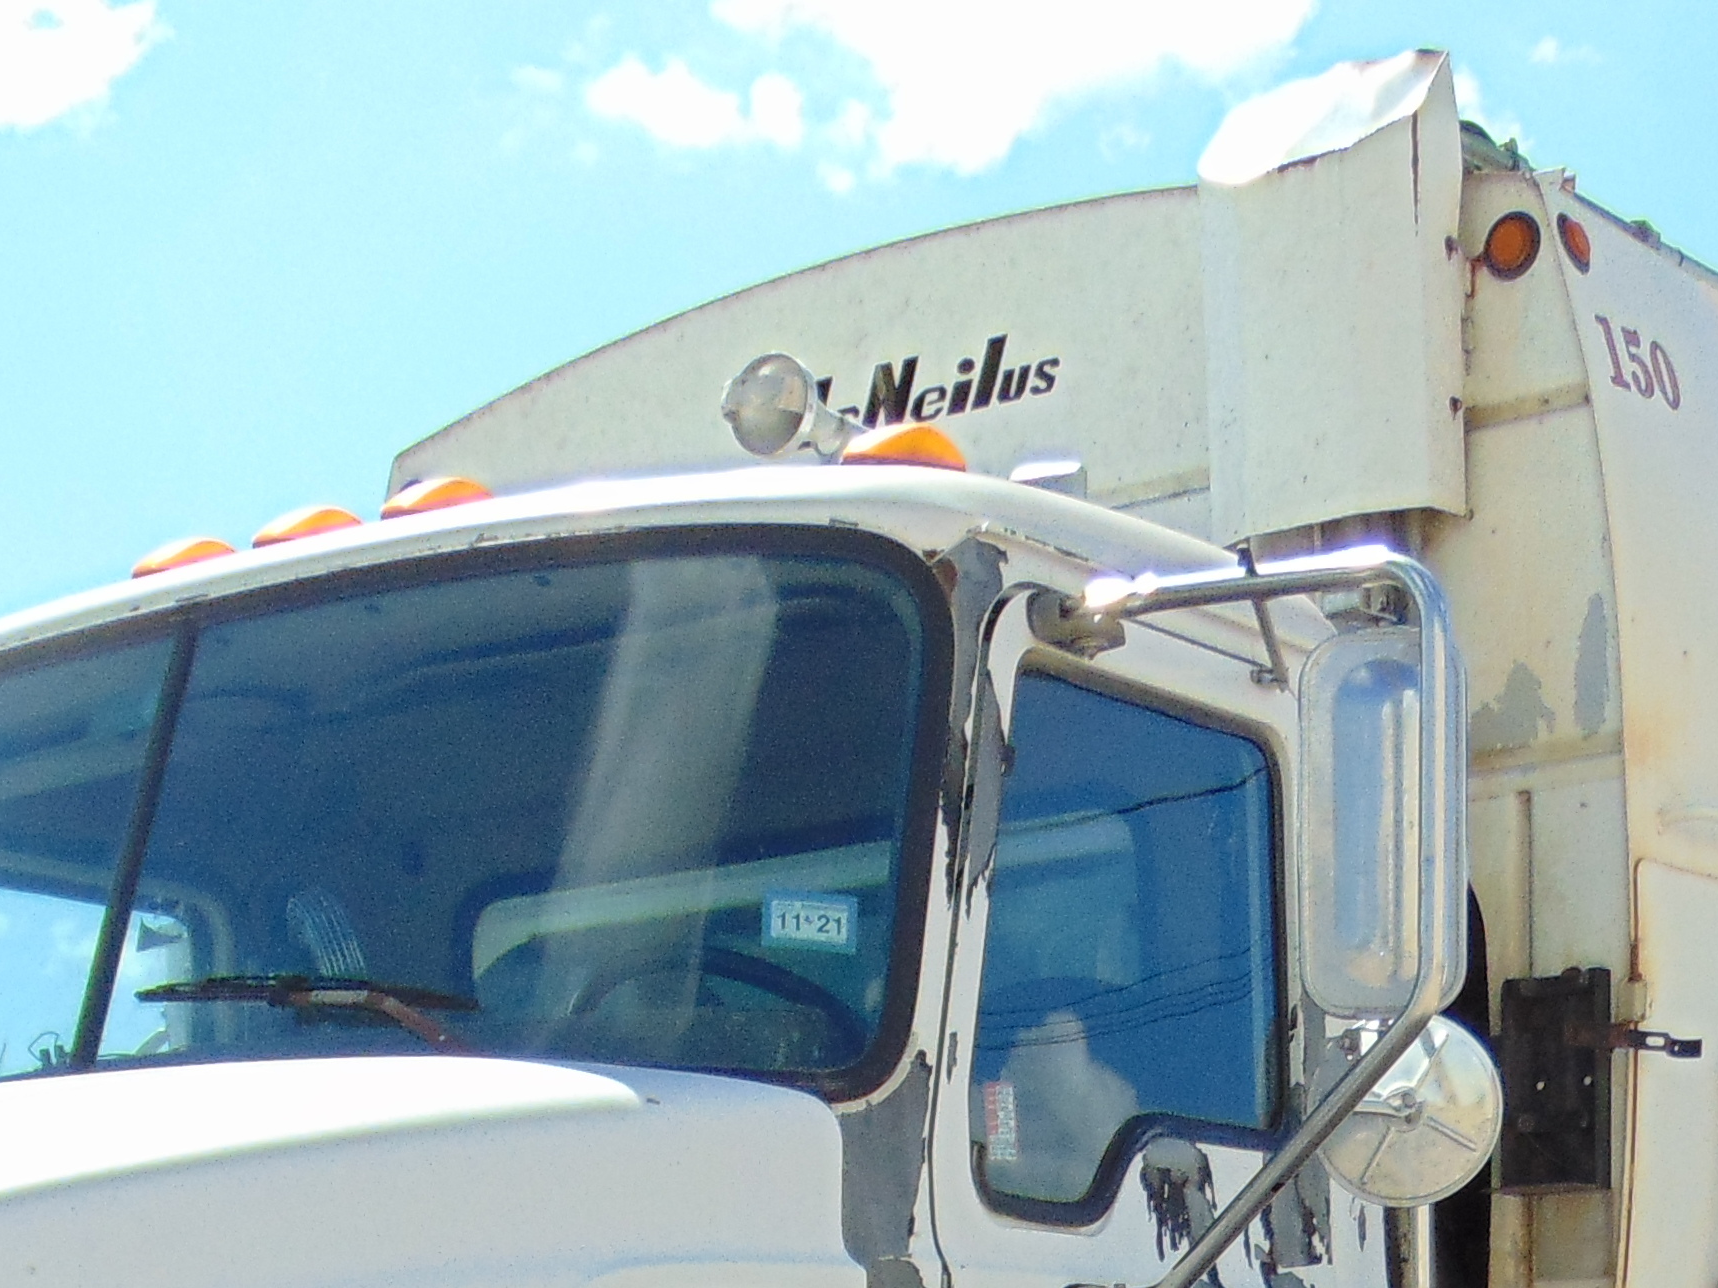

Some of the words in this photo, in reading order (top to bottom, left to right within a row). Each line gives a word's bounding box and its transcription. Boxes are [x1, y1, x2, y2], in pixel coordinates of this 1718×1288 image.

[1594, 314, 1681, 410] 150
[776, 911, 801, 932] 11
[816, 914, 843, 936] 21
